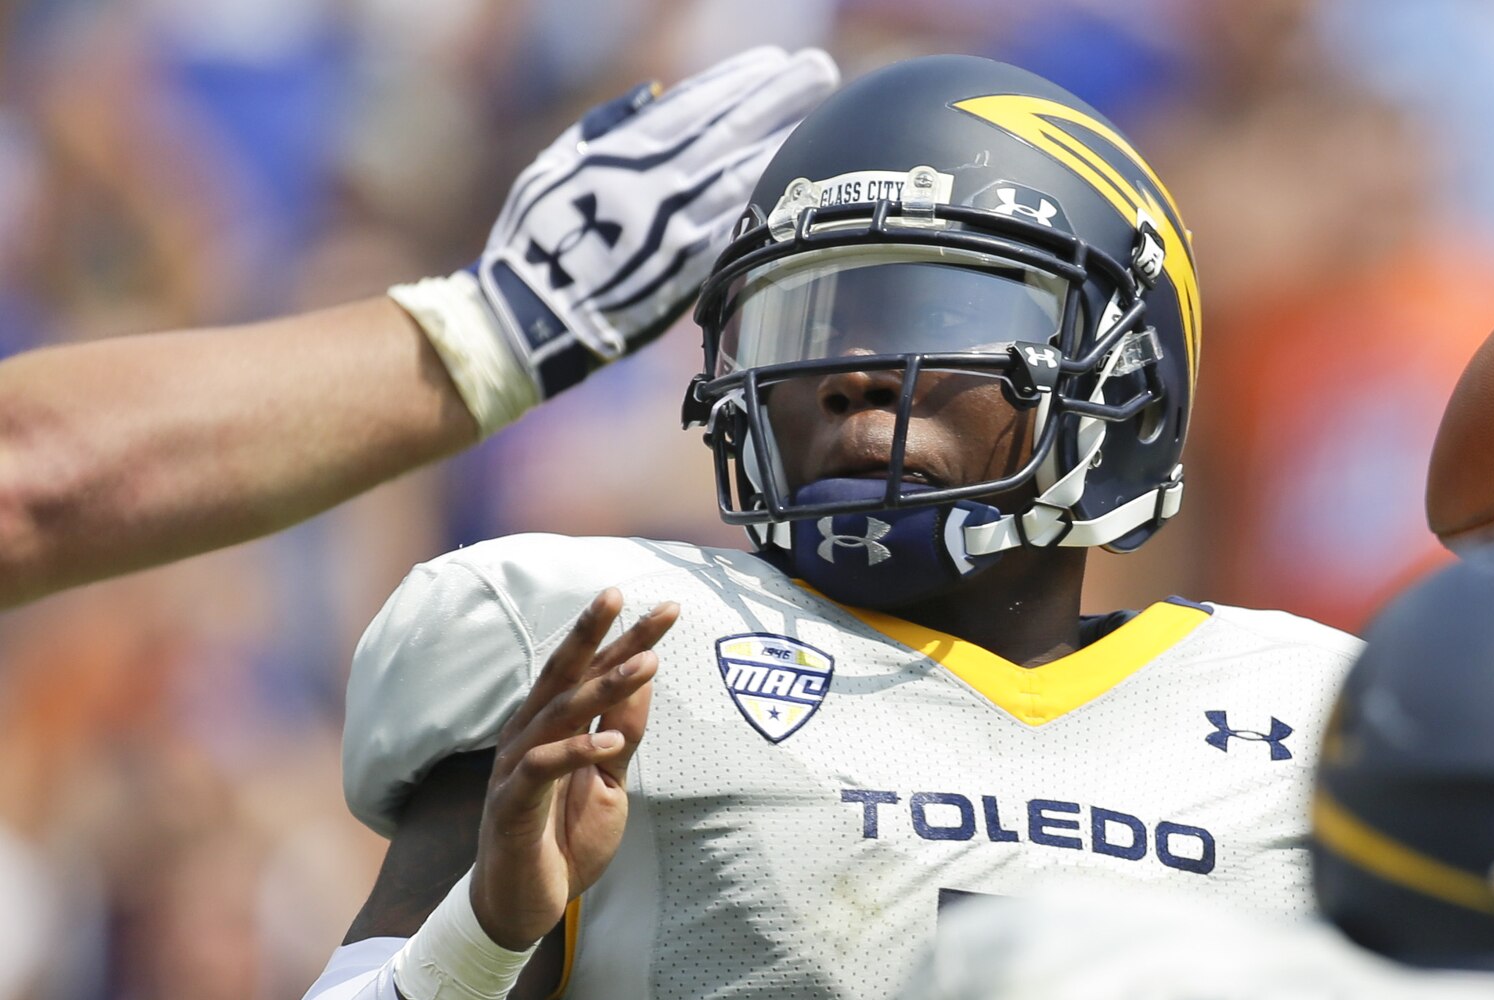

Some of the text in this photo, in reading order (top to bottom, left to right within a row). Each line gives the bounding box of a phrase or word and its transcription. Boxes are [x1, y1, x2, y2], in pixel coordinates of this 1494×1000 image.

[867, 180, 904, 201] CITY
[725, 662, 826, 702] MAC
[841, 788, 1215, 875] TOLEDO
